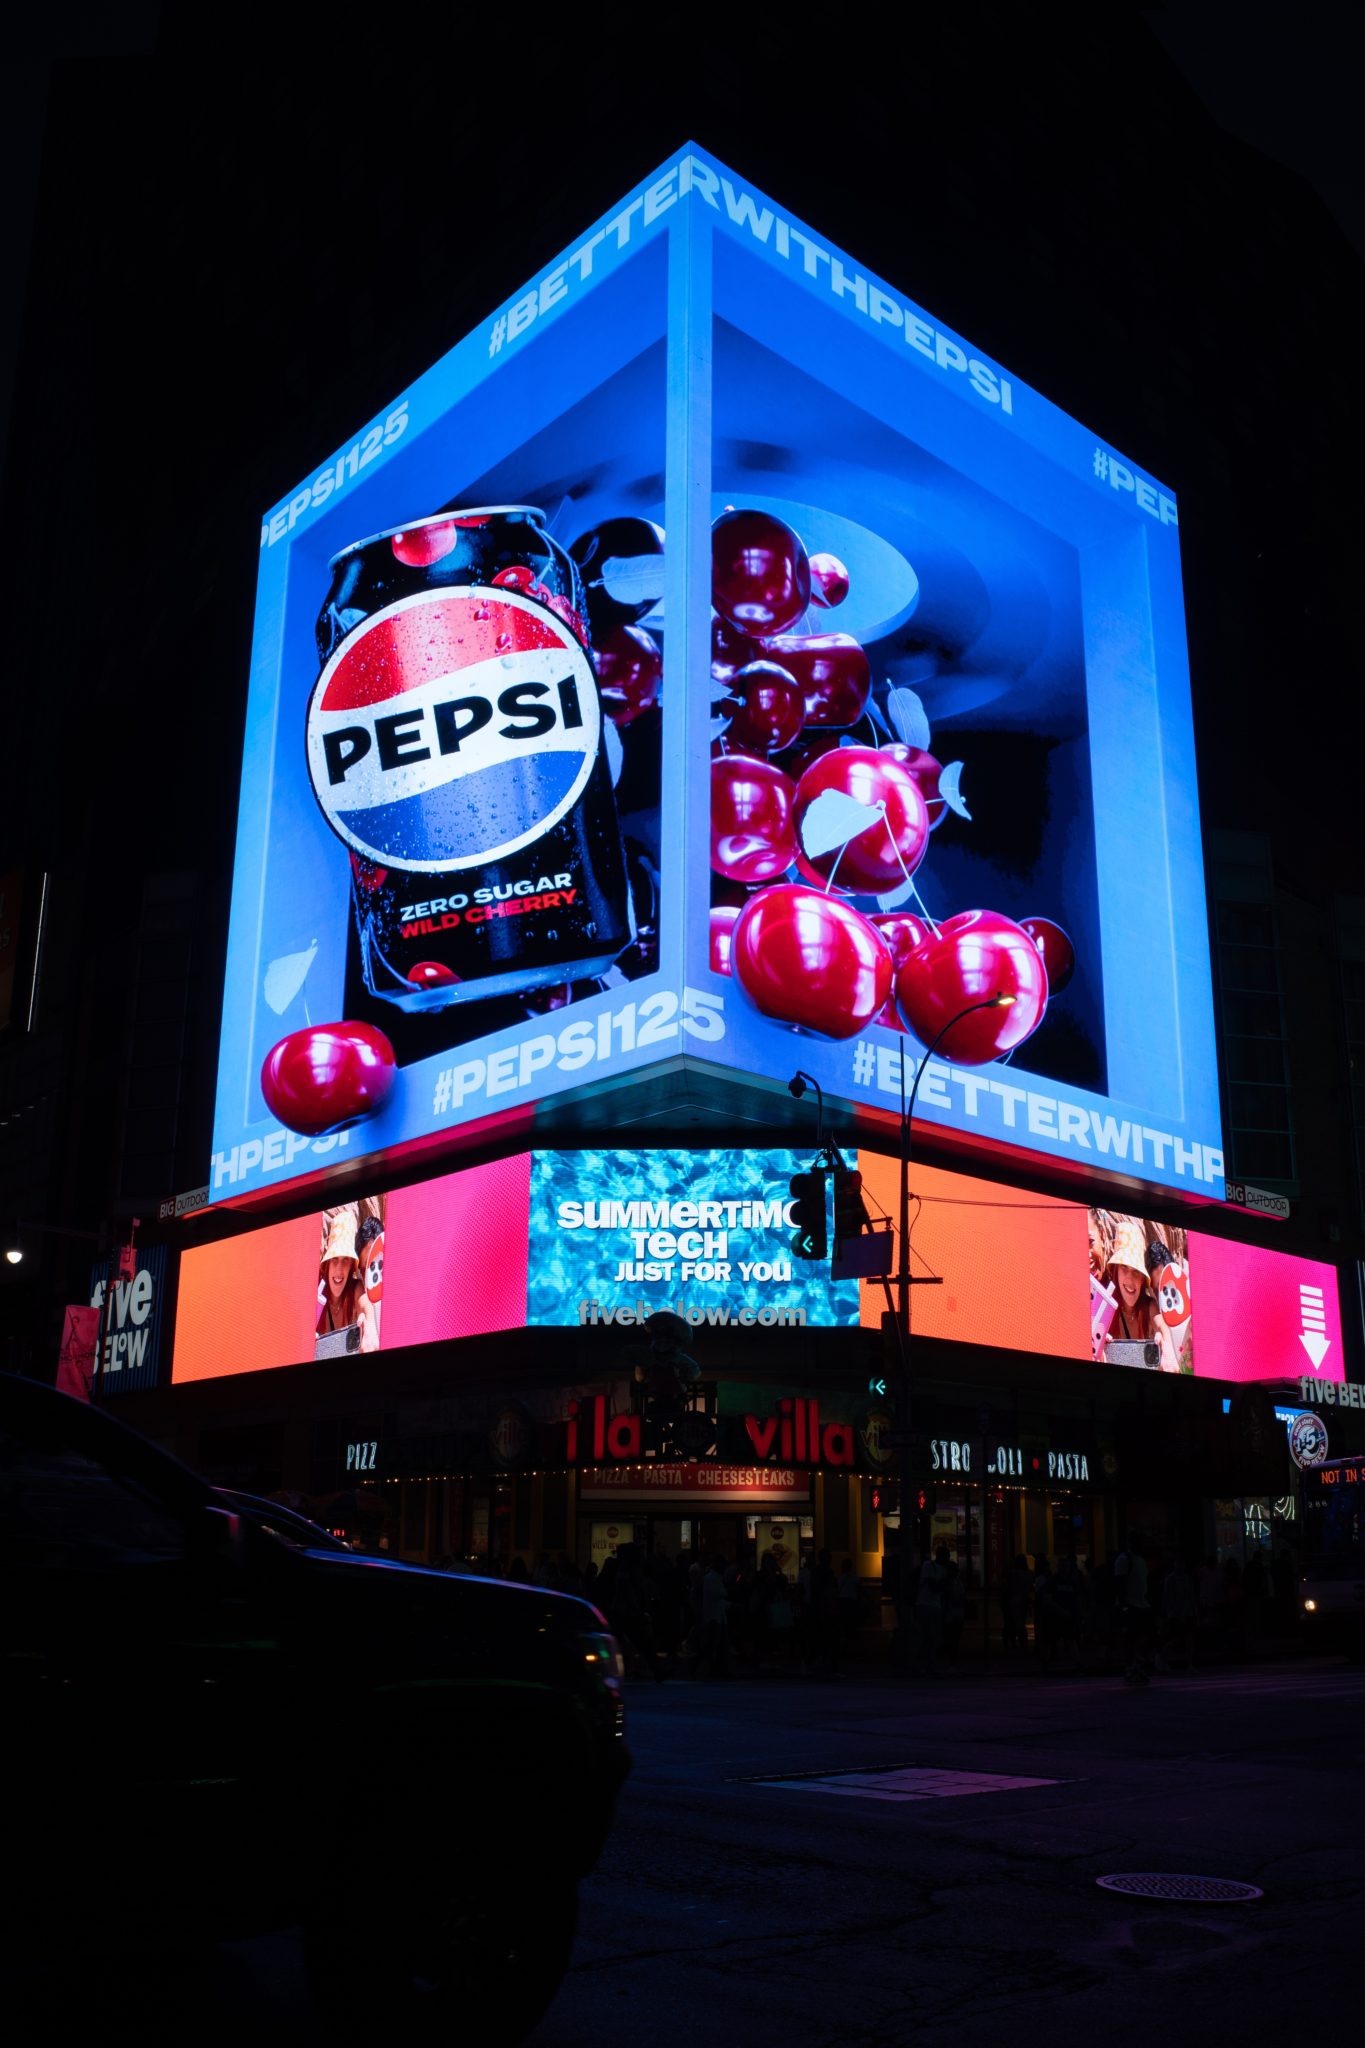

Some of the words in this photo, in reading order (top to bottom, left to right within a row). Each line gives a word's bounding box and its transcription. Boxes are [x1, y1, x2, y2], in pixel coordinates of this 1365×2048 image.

[488, 155, 1013, 415] #BETTERWITHPEPSI
[322, 674, 583, 786] PEPSI
[401, 893, 469, 922] ZERO
[473, 872, 573, 906] SUGAR
[401, 913, 461, 939] WILD
[465, 888, 578, 924] CHERRY
[433, 986, 727, 1116] #PEPSI125
[210, 1129, 350, 1189] HPEPSI
[160, 1200, 175, 1219] BIG
[176, 1191, 208, 1211] OUTDOO
[1226, 1183, 1245, 1202] BIG
[1246, 1191, 1287, 1213] OUTDOOR
[681, 1262, 731, 1282] FOR
[578, 1299, 807, 1326] fiveblow.com
[1300, 1376, 1336, 1405] five
[1338, 1381, 1365, 1410] BEL
[742, 1398, 858, 1468] villa
[594, 1468, 629, 1485] PIZZA
[643, 1468, 682, 1485] PASTA
[697, 1468, 795, 1487] CHEESESTEAKS
[1047, 1450, 1089, 1481] PASTA
[1321, 1471, 1340, 1484] NOT
[1345, 1469, 1357, 1483] IN
